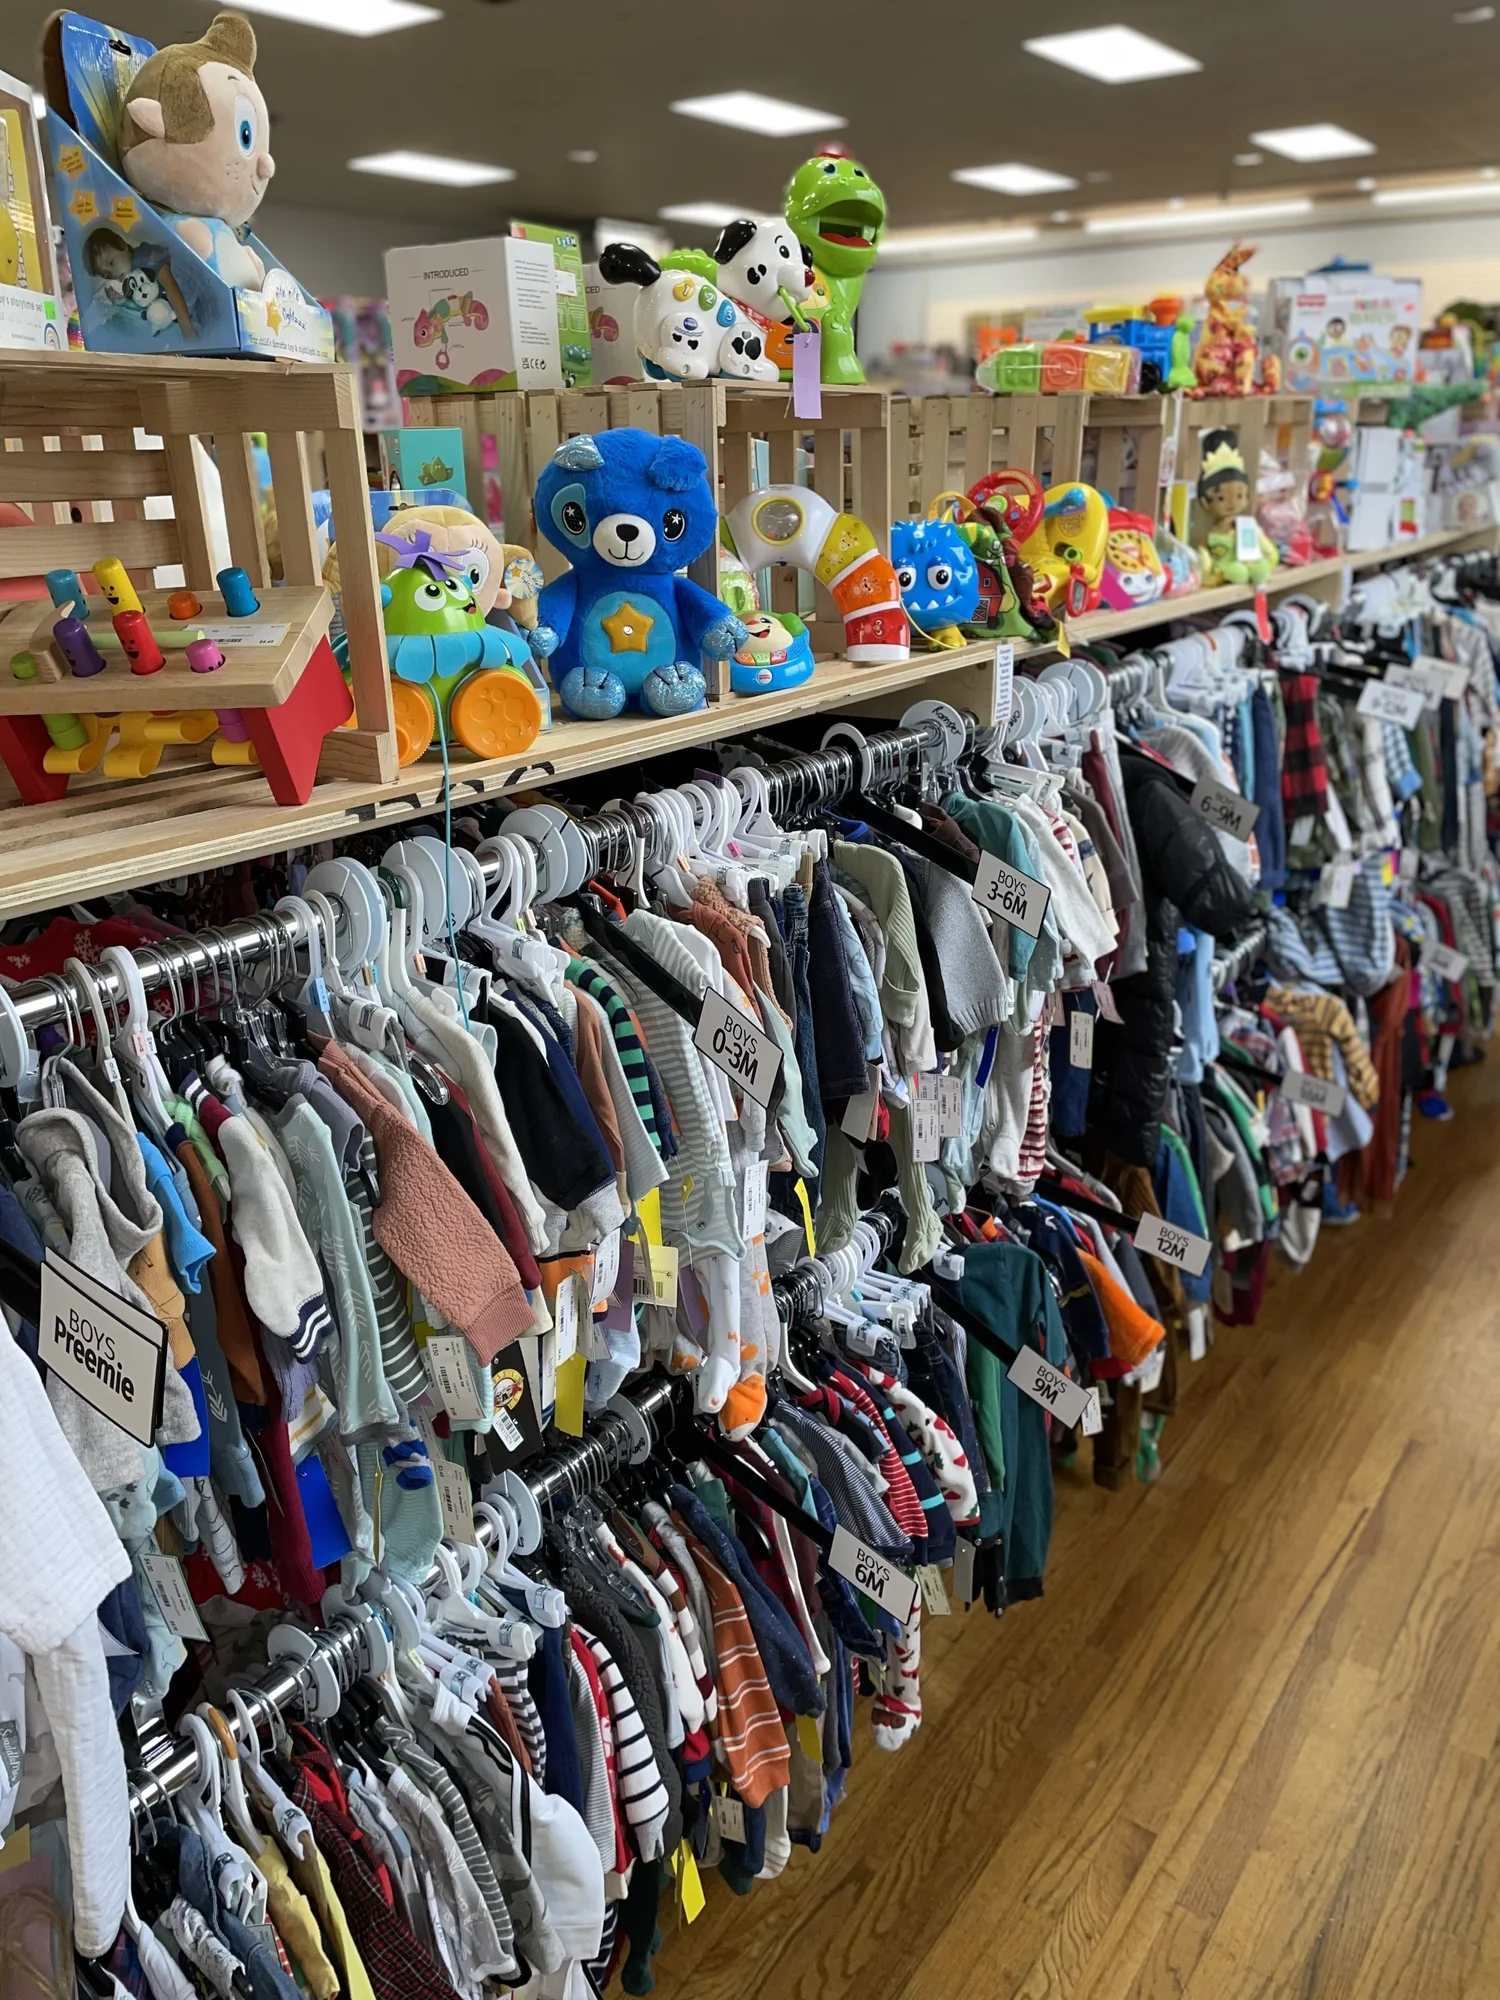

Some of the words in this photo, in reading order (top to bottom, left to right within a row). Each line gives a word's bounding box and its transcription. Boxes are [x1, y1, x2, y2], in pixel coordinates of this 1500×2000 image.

[423, 267, 449, 280] INTRODUCED
[683, 284, 691, 296] 1
[705, 292, 714, 304] 2
[726, 310, 734, 321] 3
[1200, 795, 1242, 832] 6-9M
[997, 869, 1027, 897] BOYS
[987, 880, 1028, 920] 3-6M
[723, 1014, 758, 1055] BOYS
[712, 1027, 759, 1086] 0-3M
[1157, 1237, 1186, 1262] 12M
[1159, 1226, 1190, 1248] BOYS
[69, 1307, 116, 1361] BOYS
[54, 1314, 135, 1403] Preemie
[1032, 1377, 1059, 1405] 9M
[1037, 1365, 1068, 1394] BOYS
[856, 1547, 891, 1581] BOYS
[854, 1563, 885, 1599] 6M
